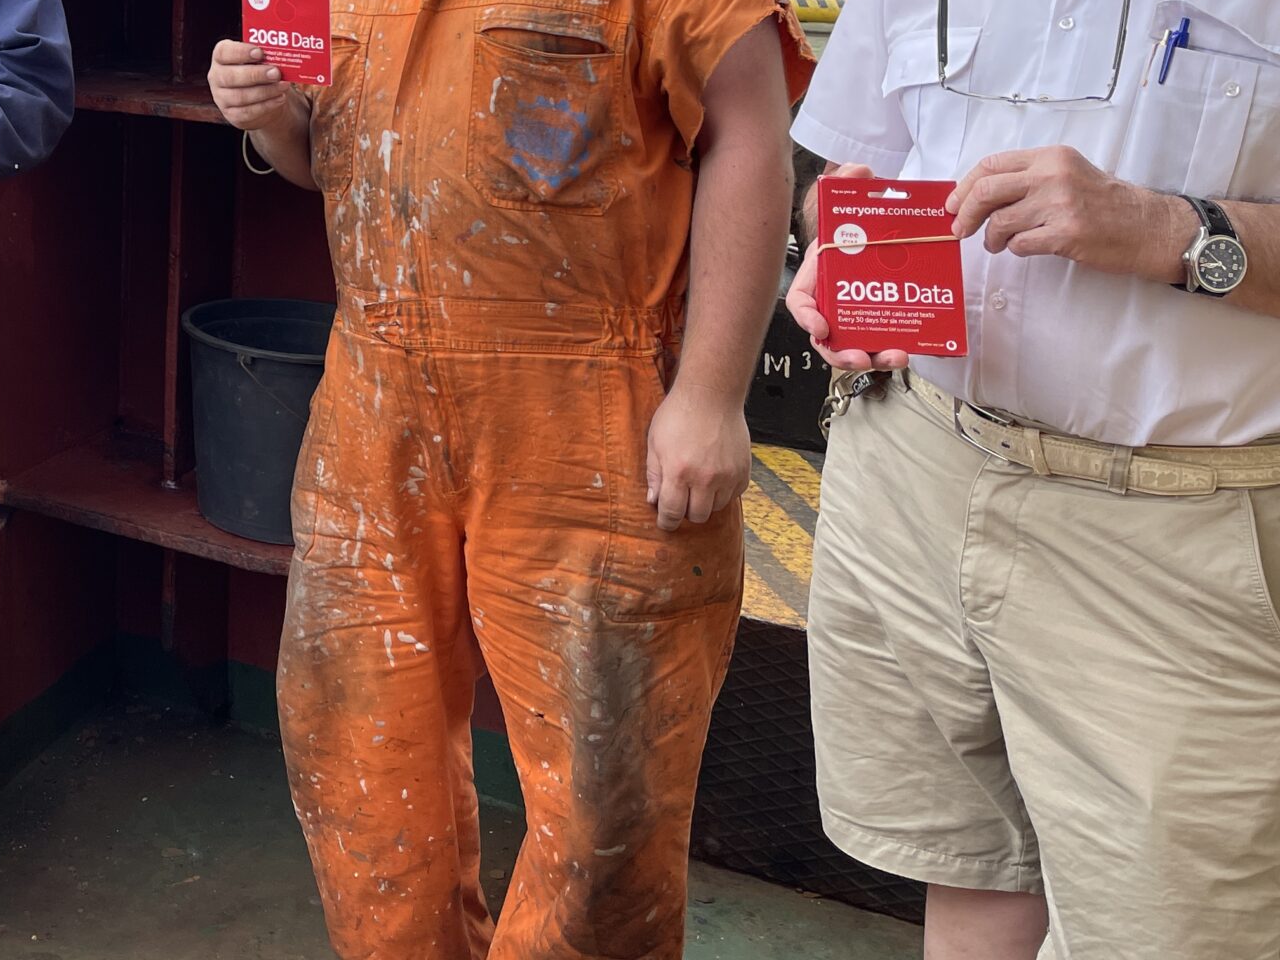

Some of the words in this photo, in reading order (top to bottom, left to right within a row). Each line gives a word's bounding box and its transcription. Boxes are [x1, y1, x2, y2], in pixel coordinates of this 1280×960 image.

[248, 28, 289, 46] 20GB
[291, 32, 324, 50] Data
[832, 206, 945, 217] everyone.connected
[840, 230, 860, 238] Free
[836, 280, 900, 302] 20GB
[904, 282, 954, 304] Data
[837, 308, 851, 316] Plus
[851, 309, 881, 317] unlimited
[837, 316, 855, 324] Every
[864, 317, 879, 325] days
[898, 318, 923, 326] months
